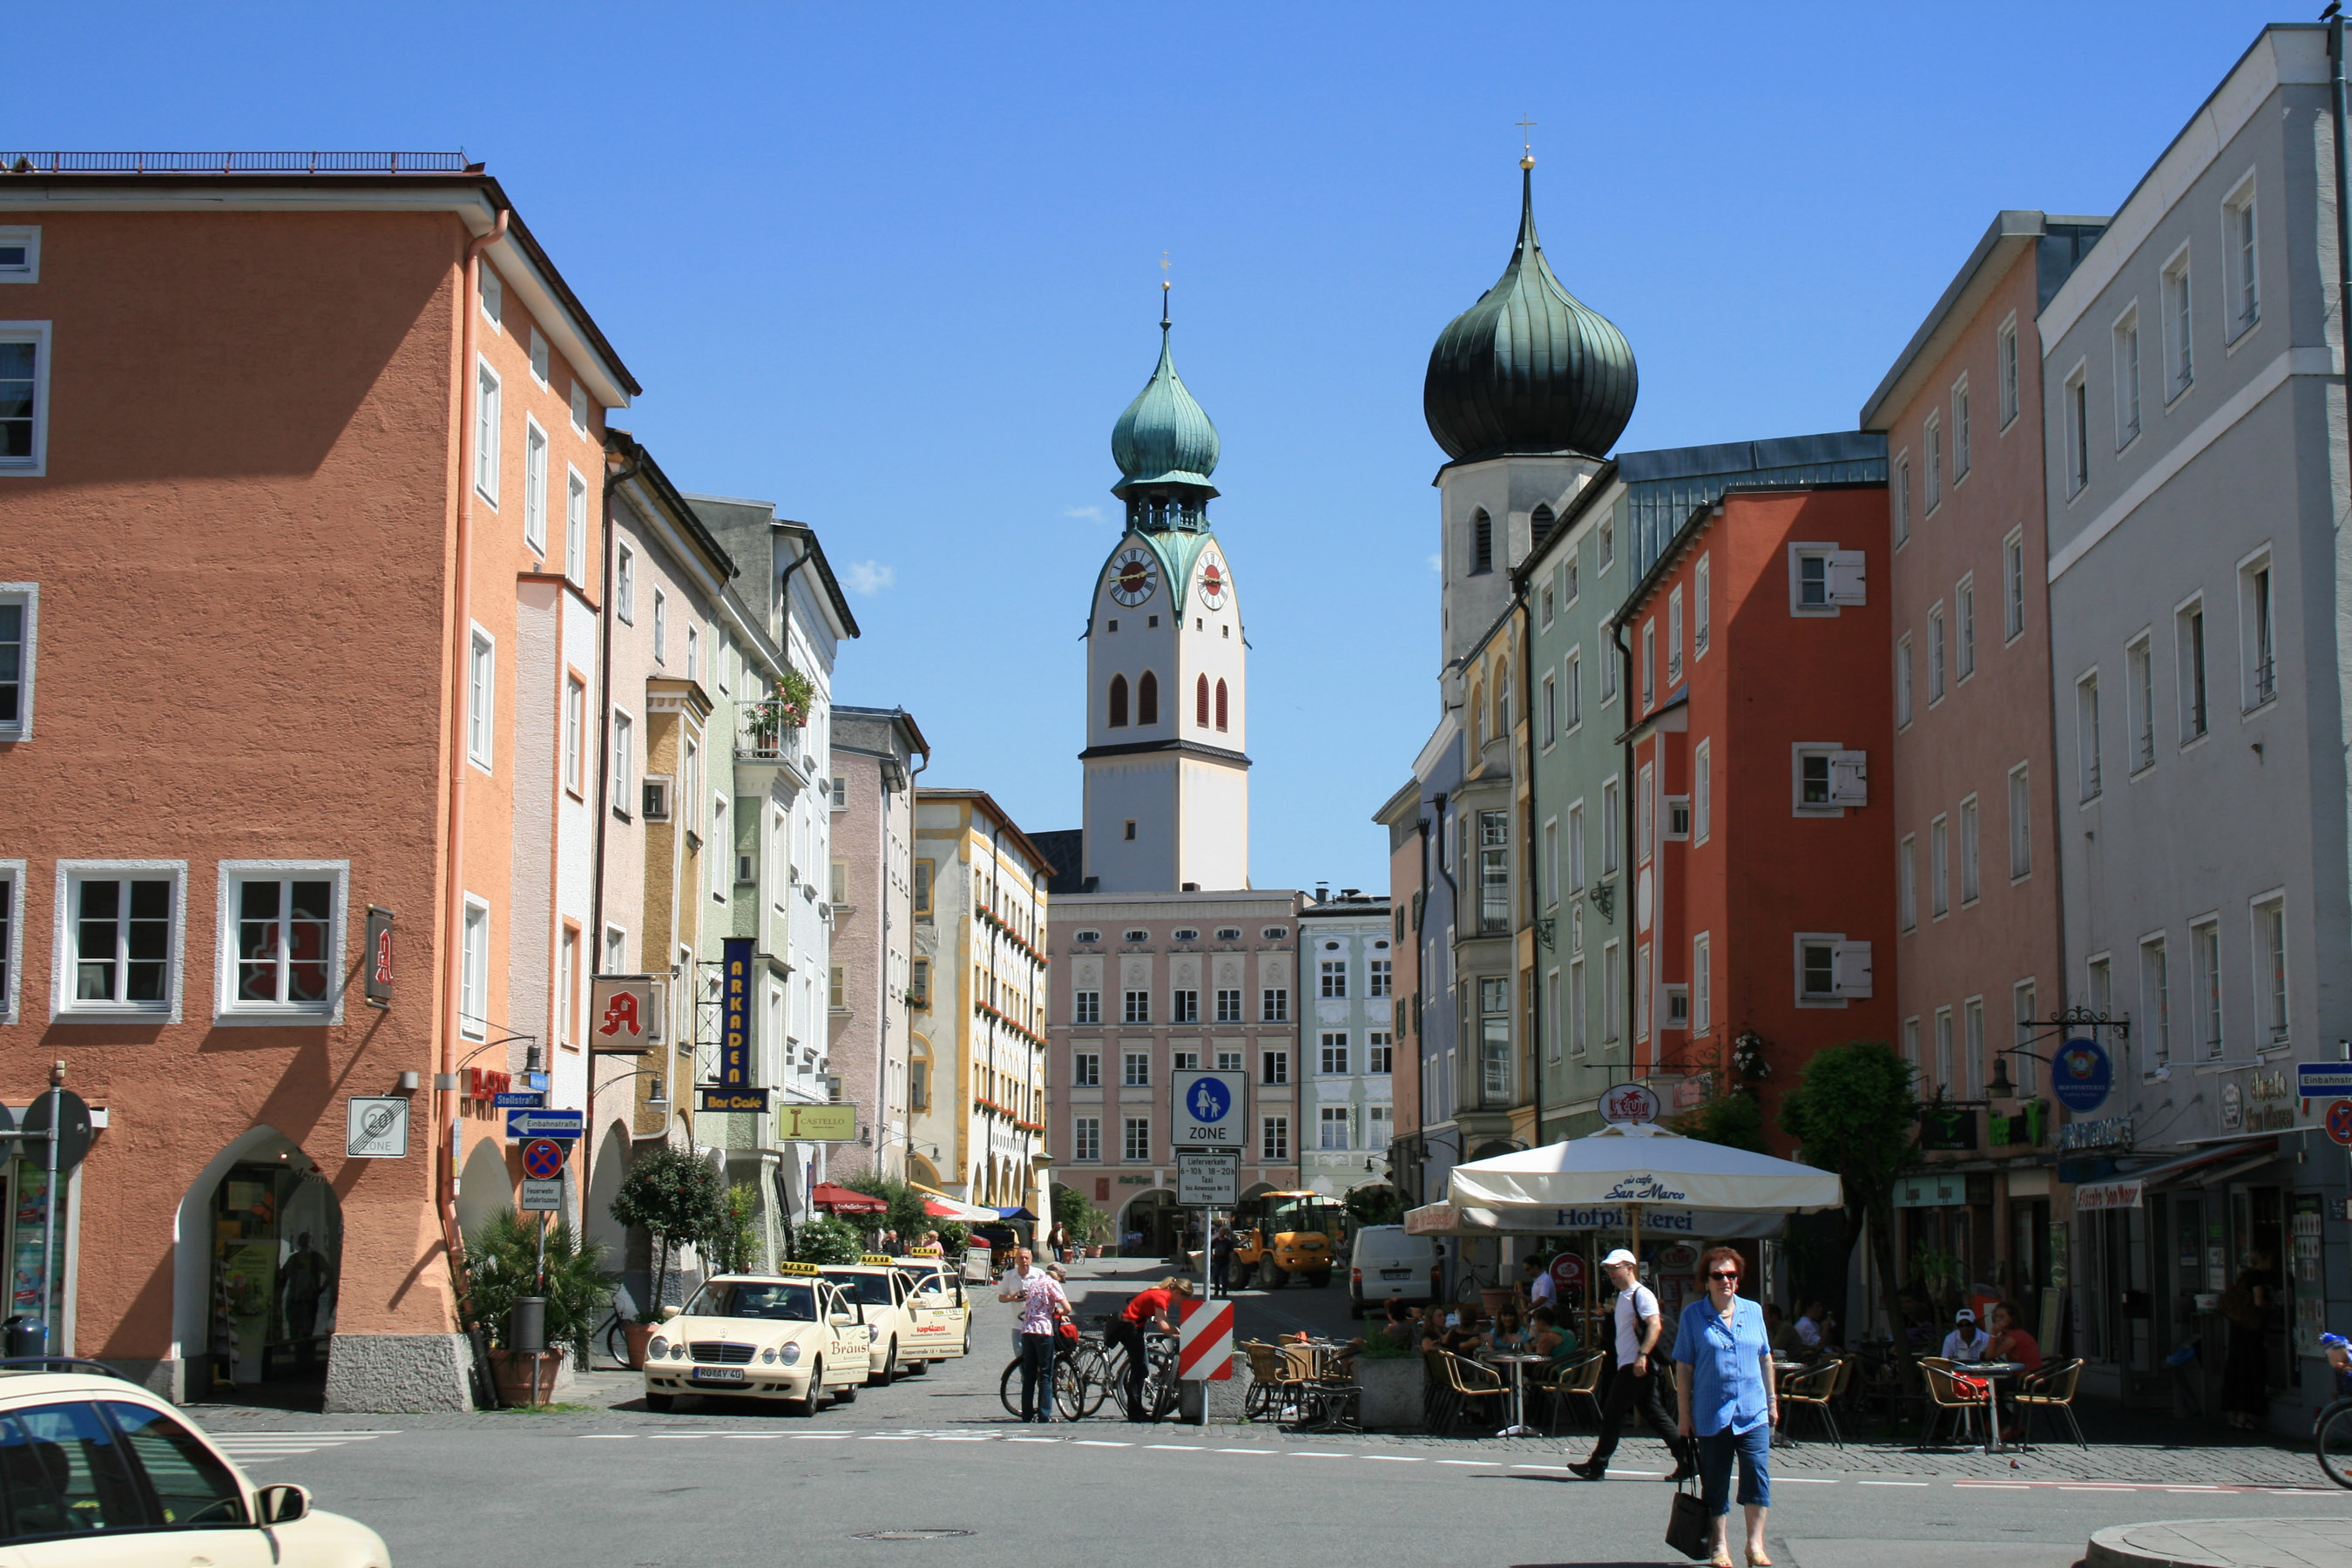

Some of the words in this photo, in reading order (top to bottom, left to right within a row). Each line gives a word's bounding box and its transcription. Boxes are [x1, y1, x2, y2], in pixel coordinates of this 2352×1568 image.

[728, 962, 742, 1083] ARKADEN
[497, 1094, 539, 1105] Stollstraße
[707, 1096, 728, 1108] Bar
[731, 1096, 762, 1108] Café
[1189, 1127, 1226, 1139] ZONE
[1604, 1184, 1633, 1200] San
[1637, 1183, 1685, 1200] Marco
[786, 1263, 811, 1272] TAXI
[700, 1369, 712, 1377] RO
